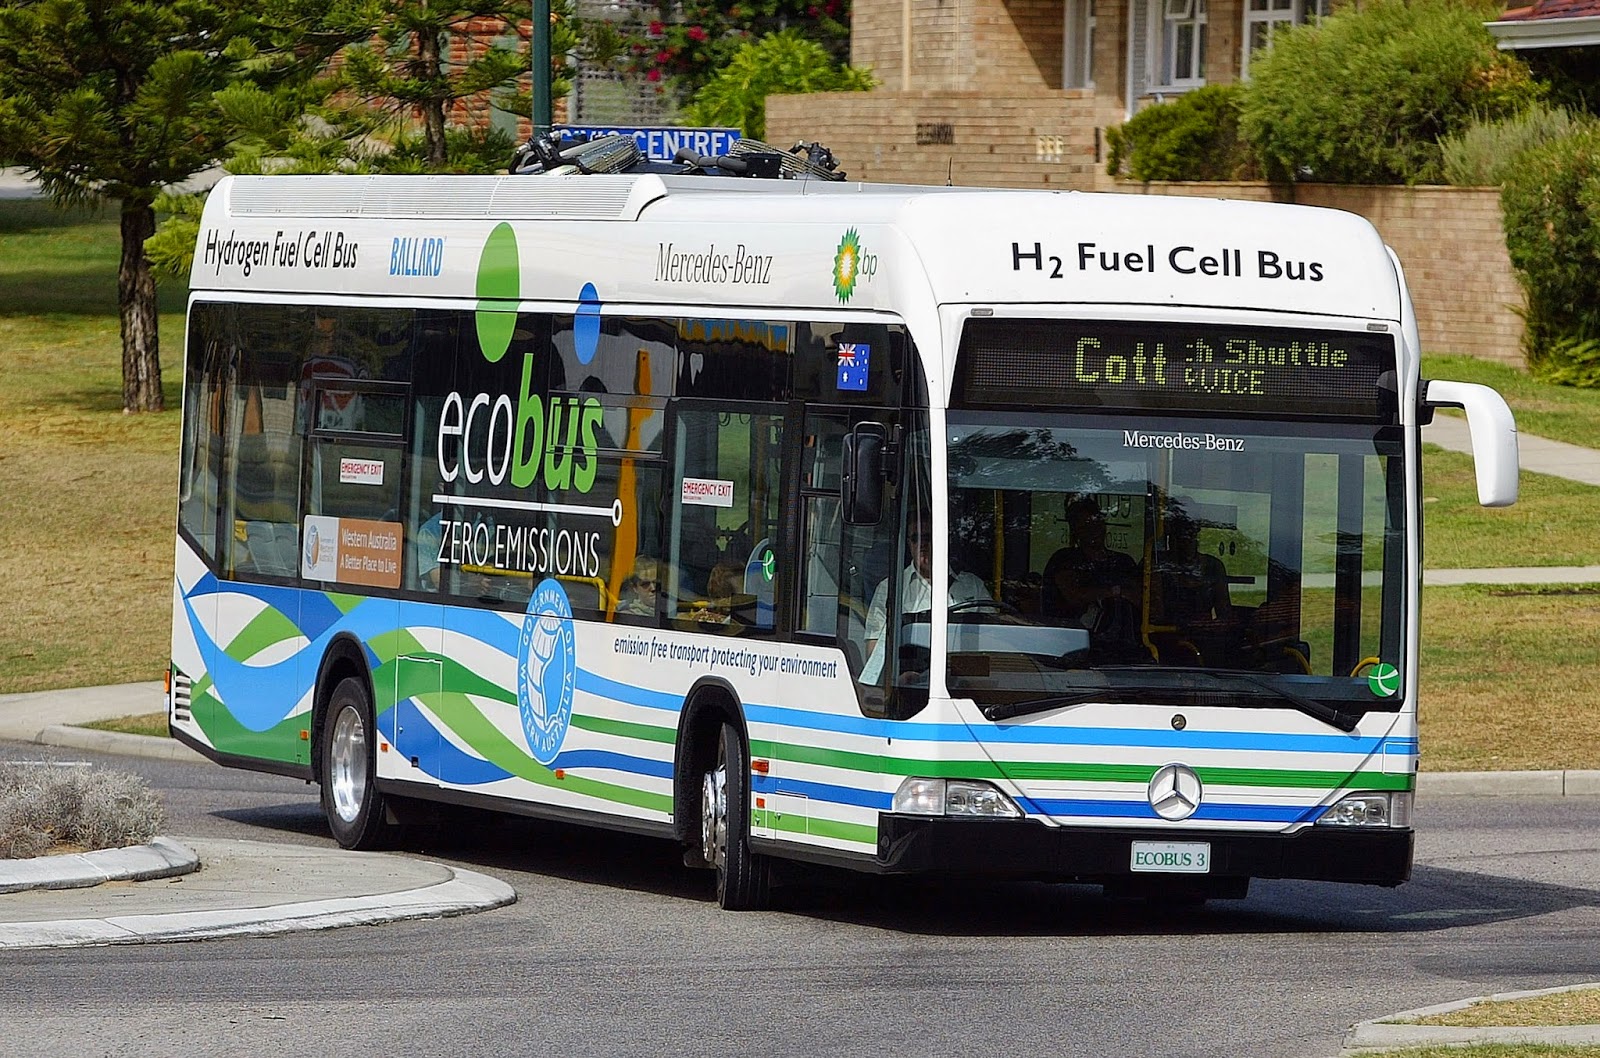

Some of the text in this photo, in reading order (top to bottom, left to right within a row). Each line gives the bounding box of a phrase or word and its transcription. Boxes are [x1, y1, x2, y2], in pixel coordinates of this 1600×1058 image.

[204, 229, 358, 277] Hydrogen Fuel Cell Bus
[389, 237, 444, 277] BALLARD
[654, 242, 773, 284] Mercedes-Benz
[862, 247, 878, 282] bp
[1077, 243, 1155, 273] Fuel
[1168, 246, 1242, 277] Cell
[1257, 250, 1324, 282] Bus
[1075, 337, 1167, 385] Cott
[1224, 339, 1348, 367] Shuttle
[438, 353, 604, 494] ecobus
[1123, 430, 1245, 452] Mercedes-Benz
[341, 462, 382, 476] EMERGENCY EXIT
[683, 482, 731, 497] EMERGENCY EXIT
[341, 527, 397, 551] Western Australia
[437, 520, 600, 577] ZERO EMISSIONS
[345, 554, 362, 570] Better
[362, 556, 377, 571] Place
[377, 560, 384, 572] to
[385, 558, 397, 574] Live
[522, 588, 569, 646] GOVERNMENT
[614, 635, 838, 679] emission free transport protecting your environment
[520, 663, 573, 752] WESTERN AUSTRALIA
[1135, 852, 1205, 866] ECOBUS 3
